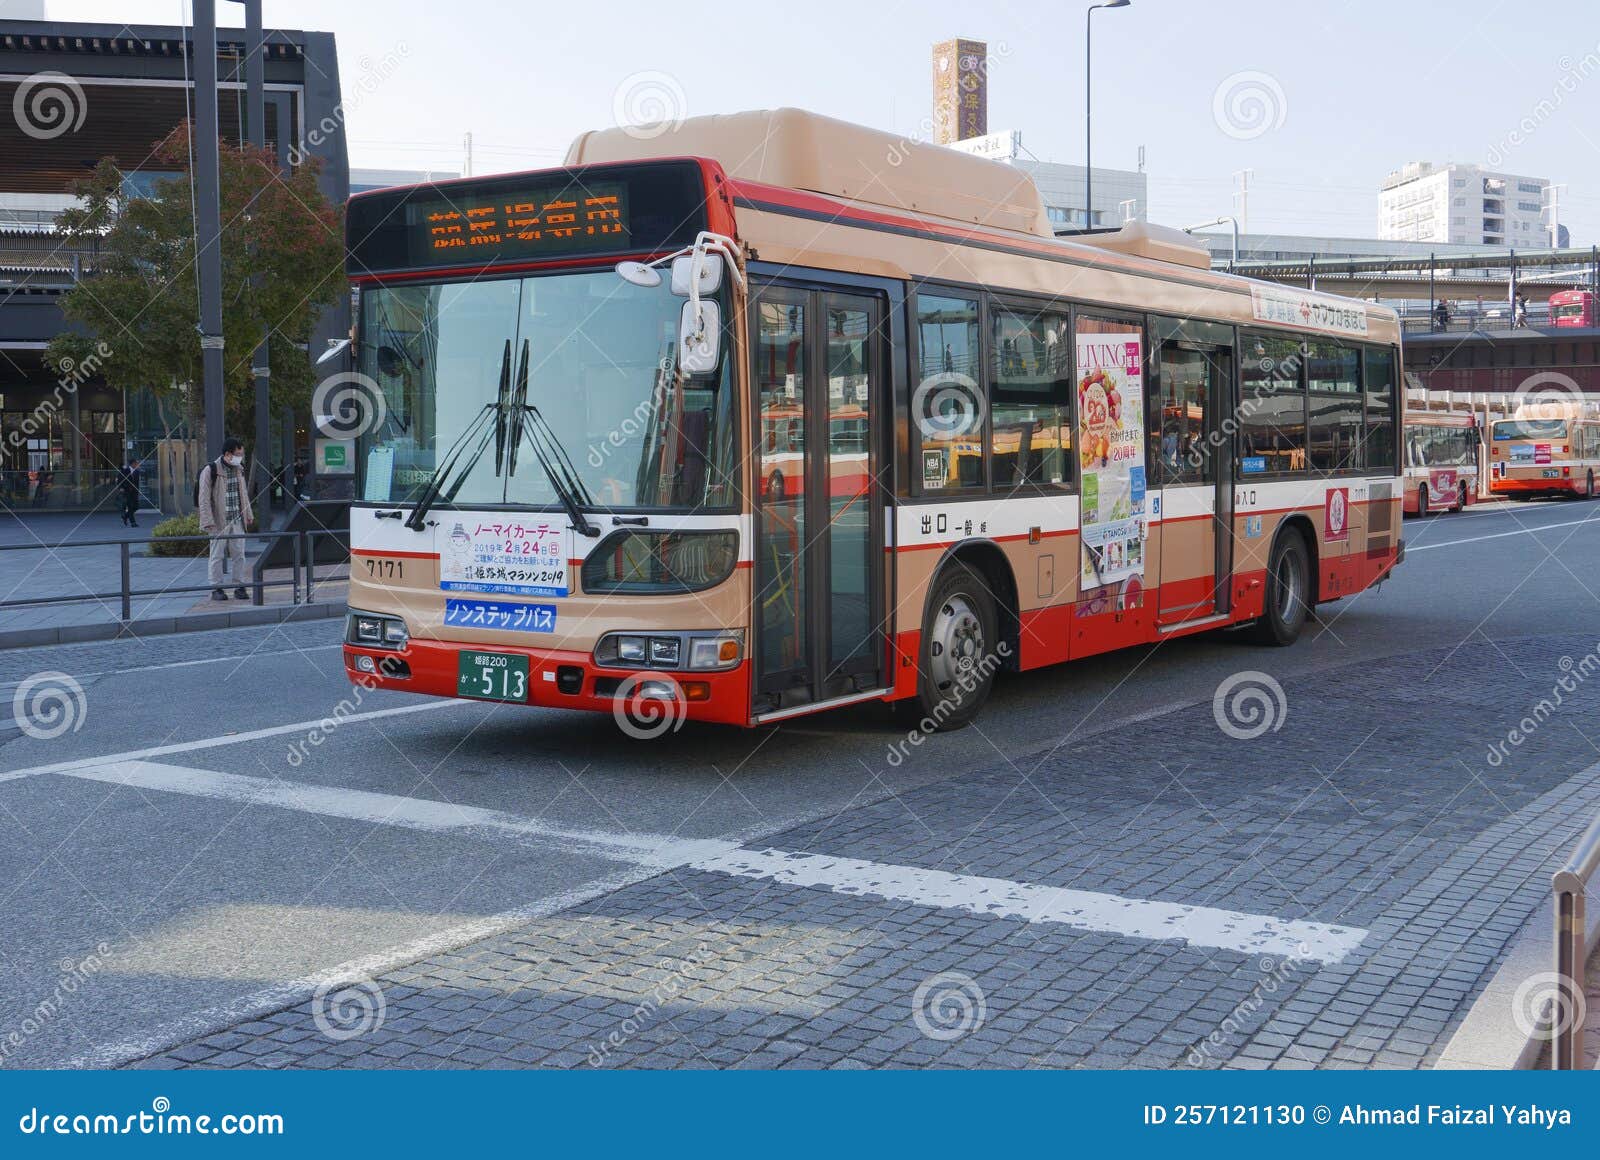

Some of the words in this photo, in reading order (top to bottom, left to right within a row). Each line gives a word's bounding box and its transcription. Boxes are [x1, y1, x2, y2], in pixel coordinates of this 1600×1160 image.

[1077, 344, 1126, 368] LIVING
[1110, 430, 1139, 443] おかげさまで
[1113, 446, 1136, 462] 20周年
[1242, 491, 1256, 505] 入口
[474, 524, 561, 539] ノーマイカーデー
[921, 513, 947, 535] 出口
[955, 519, 973, 536] 一般
[366, 559, 404, 579] 7171
[446, 602, 553, 628] ノンステップバス
